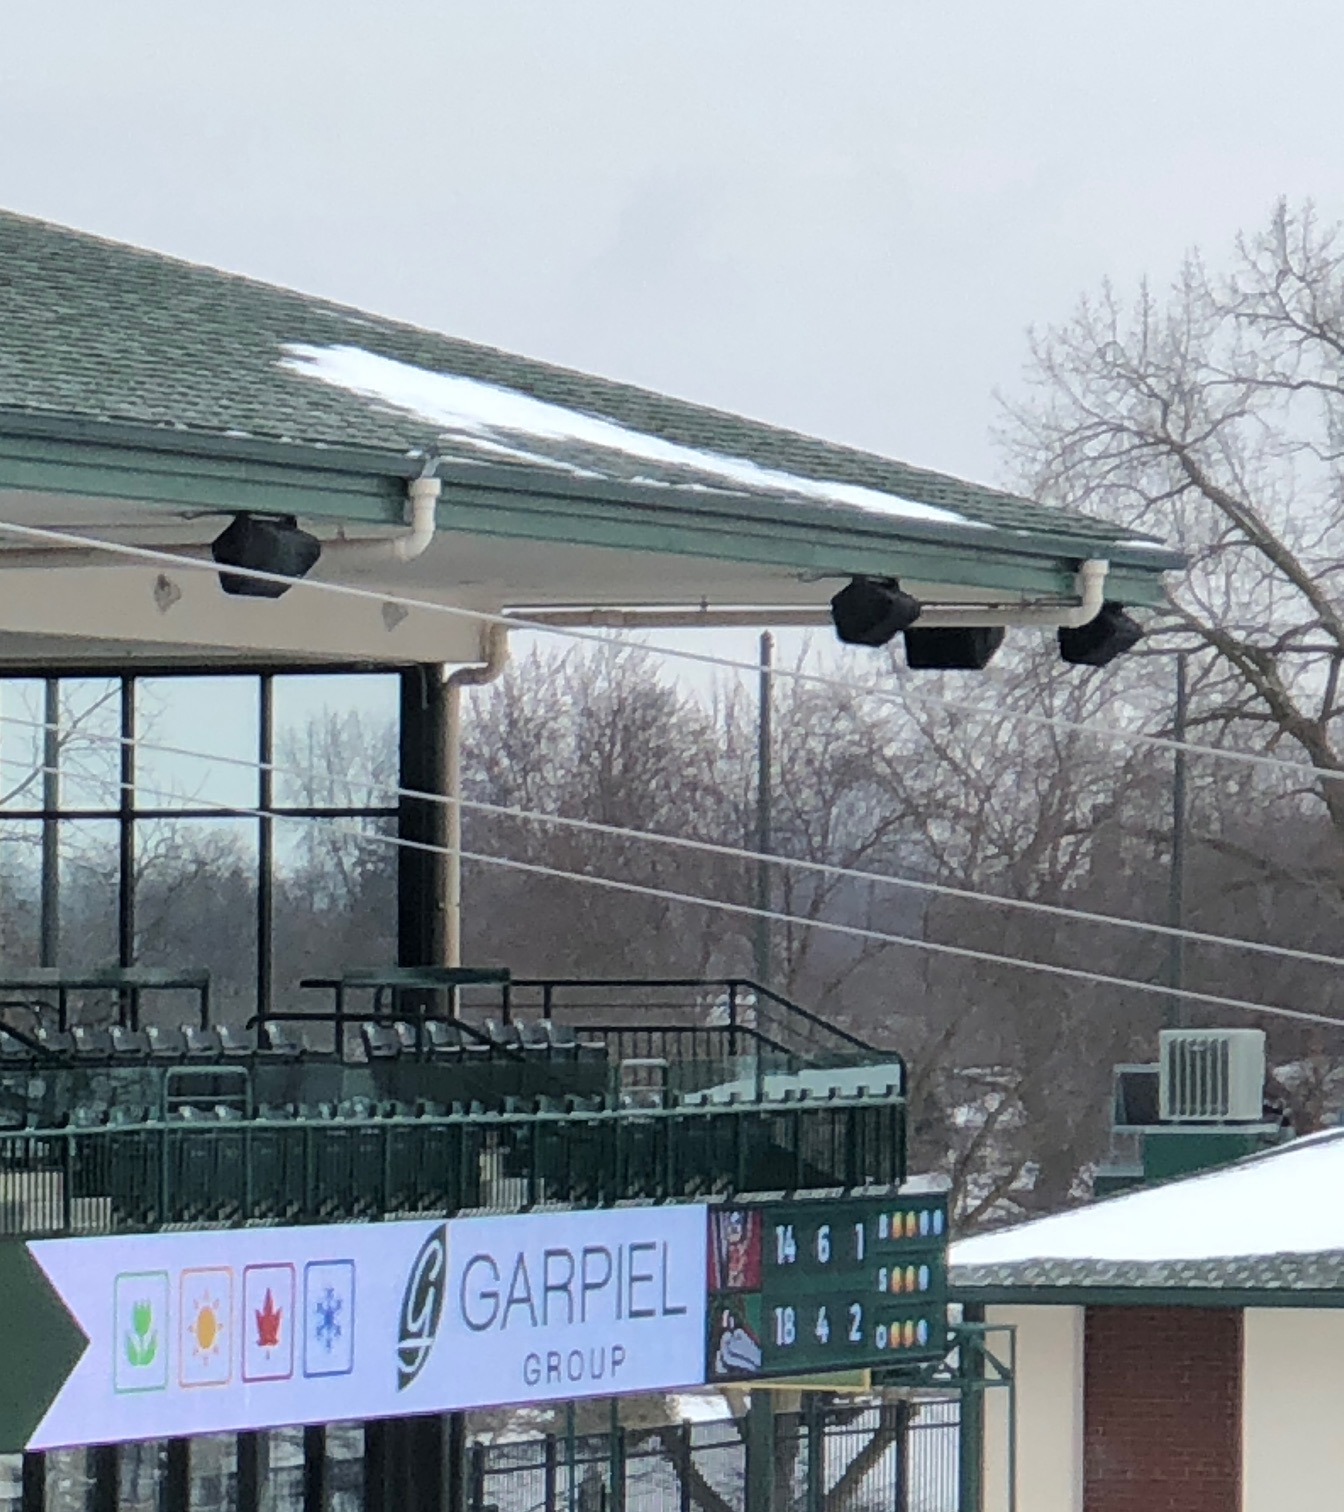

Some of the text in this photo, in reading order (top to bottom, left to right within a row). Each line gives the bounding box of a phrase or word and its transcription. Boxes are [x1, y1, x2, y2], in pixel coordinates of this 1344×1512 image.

[817, 1225, 830, 1263] 6
[855, 1222, 864, 1260] 1
[459, 1240, 687, 1333] GARPIEL
[775, 1303, 862, 1346] 18 4 2
[524, 1346, 627, 1387] GROUP
